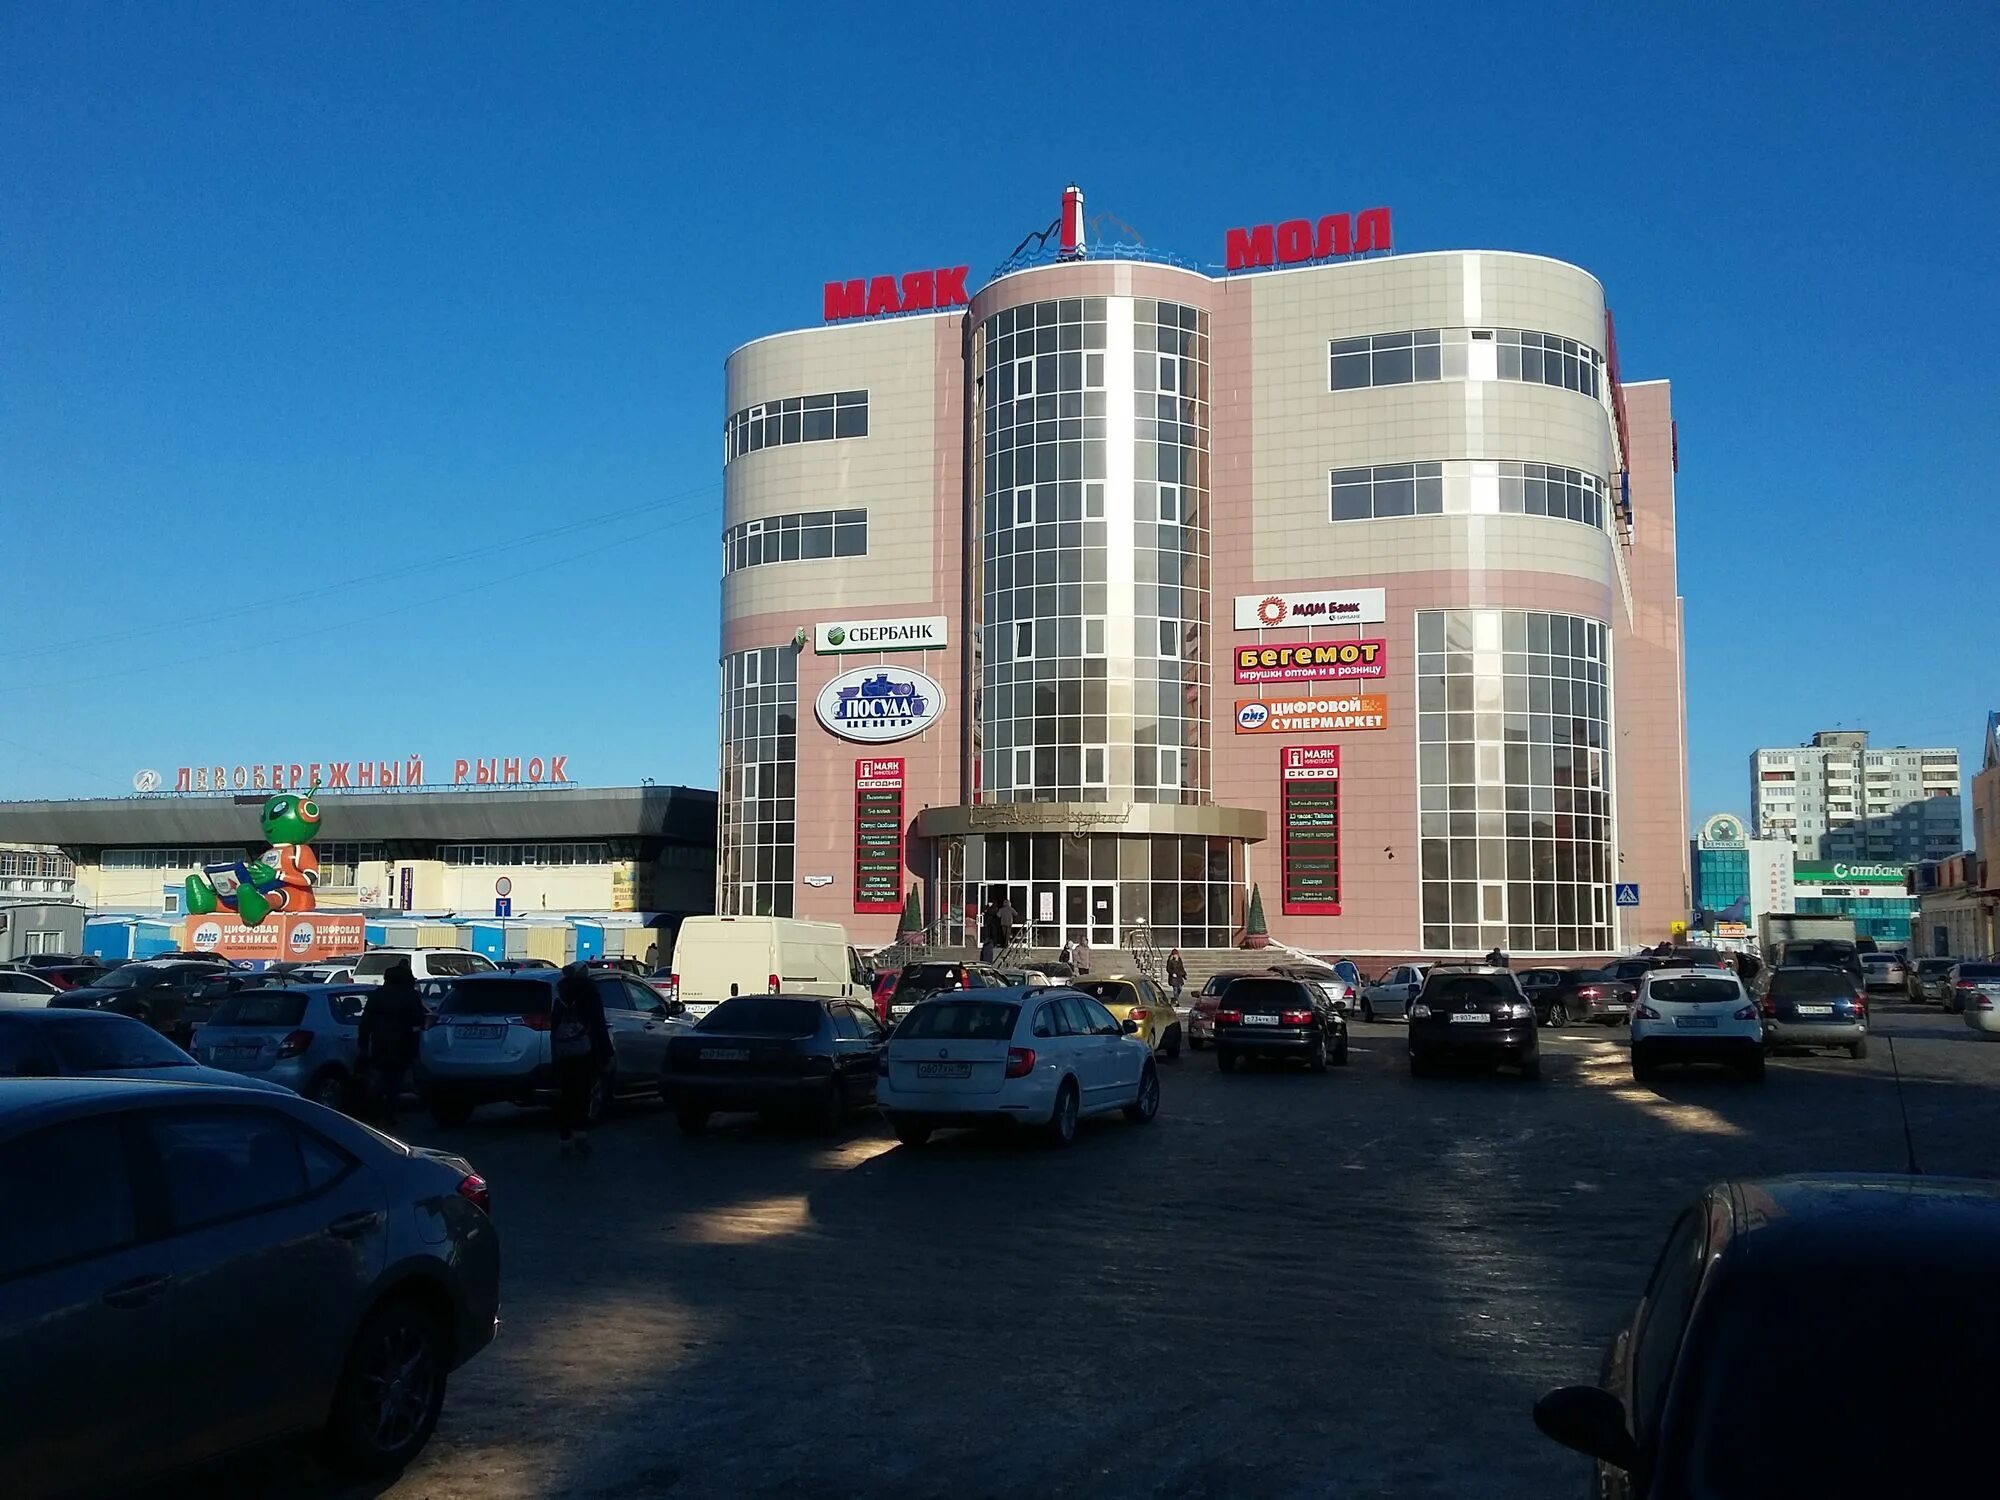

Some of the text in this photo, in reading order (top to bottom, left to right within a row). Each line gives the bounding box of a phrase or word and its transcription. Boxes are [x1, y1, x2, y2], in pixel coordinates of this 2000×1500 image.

[824, 206, 1391, 320] МАЯК МОЛЛ
[1292, 602, 1360, 617] МДМ Банк
[849, 624, 932, 641] СБЕРБАНК
[1240, 670, 1282, 681] игрушки
[1285, 668, 1316, 677] оптом
[1329, 667, 1335, 675] в
[1339, 665, 1381, 677] розницу
[846, 698, 911, 717] ПОСУДА
[1271, 697, 1360, 716] ЦИФРОВОЙ
[1242, 710, 1265, 721] DNS
[846, 719, 912, 728] ЦЕНТР
[1271, 715, 1383, 730] СУПЕРМАРКЕТ
[1304, 750, 1334, 759] МАЯК
[874, 762, 899, 770] МАЯК
[175, 753, 568, 792] ЛЕВОБЕРЕЖНЫЙ РЫНОК
[224, 925, 279, 934] ЦИФРОВАЯ
[316, 926, 360, 934] ЦИФРОВАЯ
[197, 933, 218, 942] DNS
[224, 935, 278, 943] ТЕХНИКА
[294, 934, 311, 943] DNS
[316, 936, 359, 944] ТЕХНИКА
